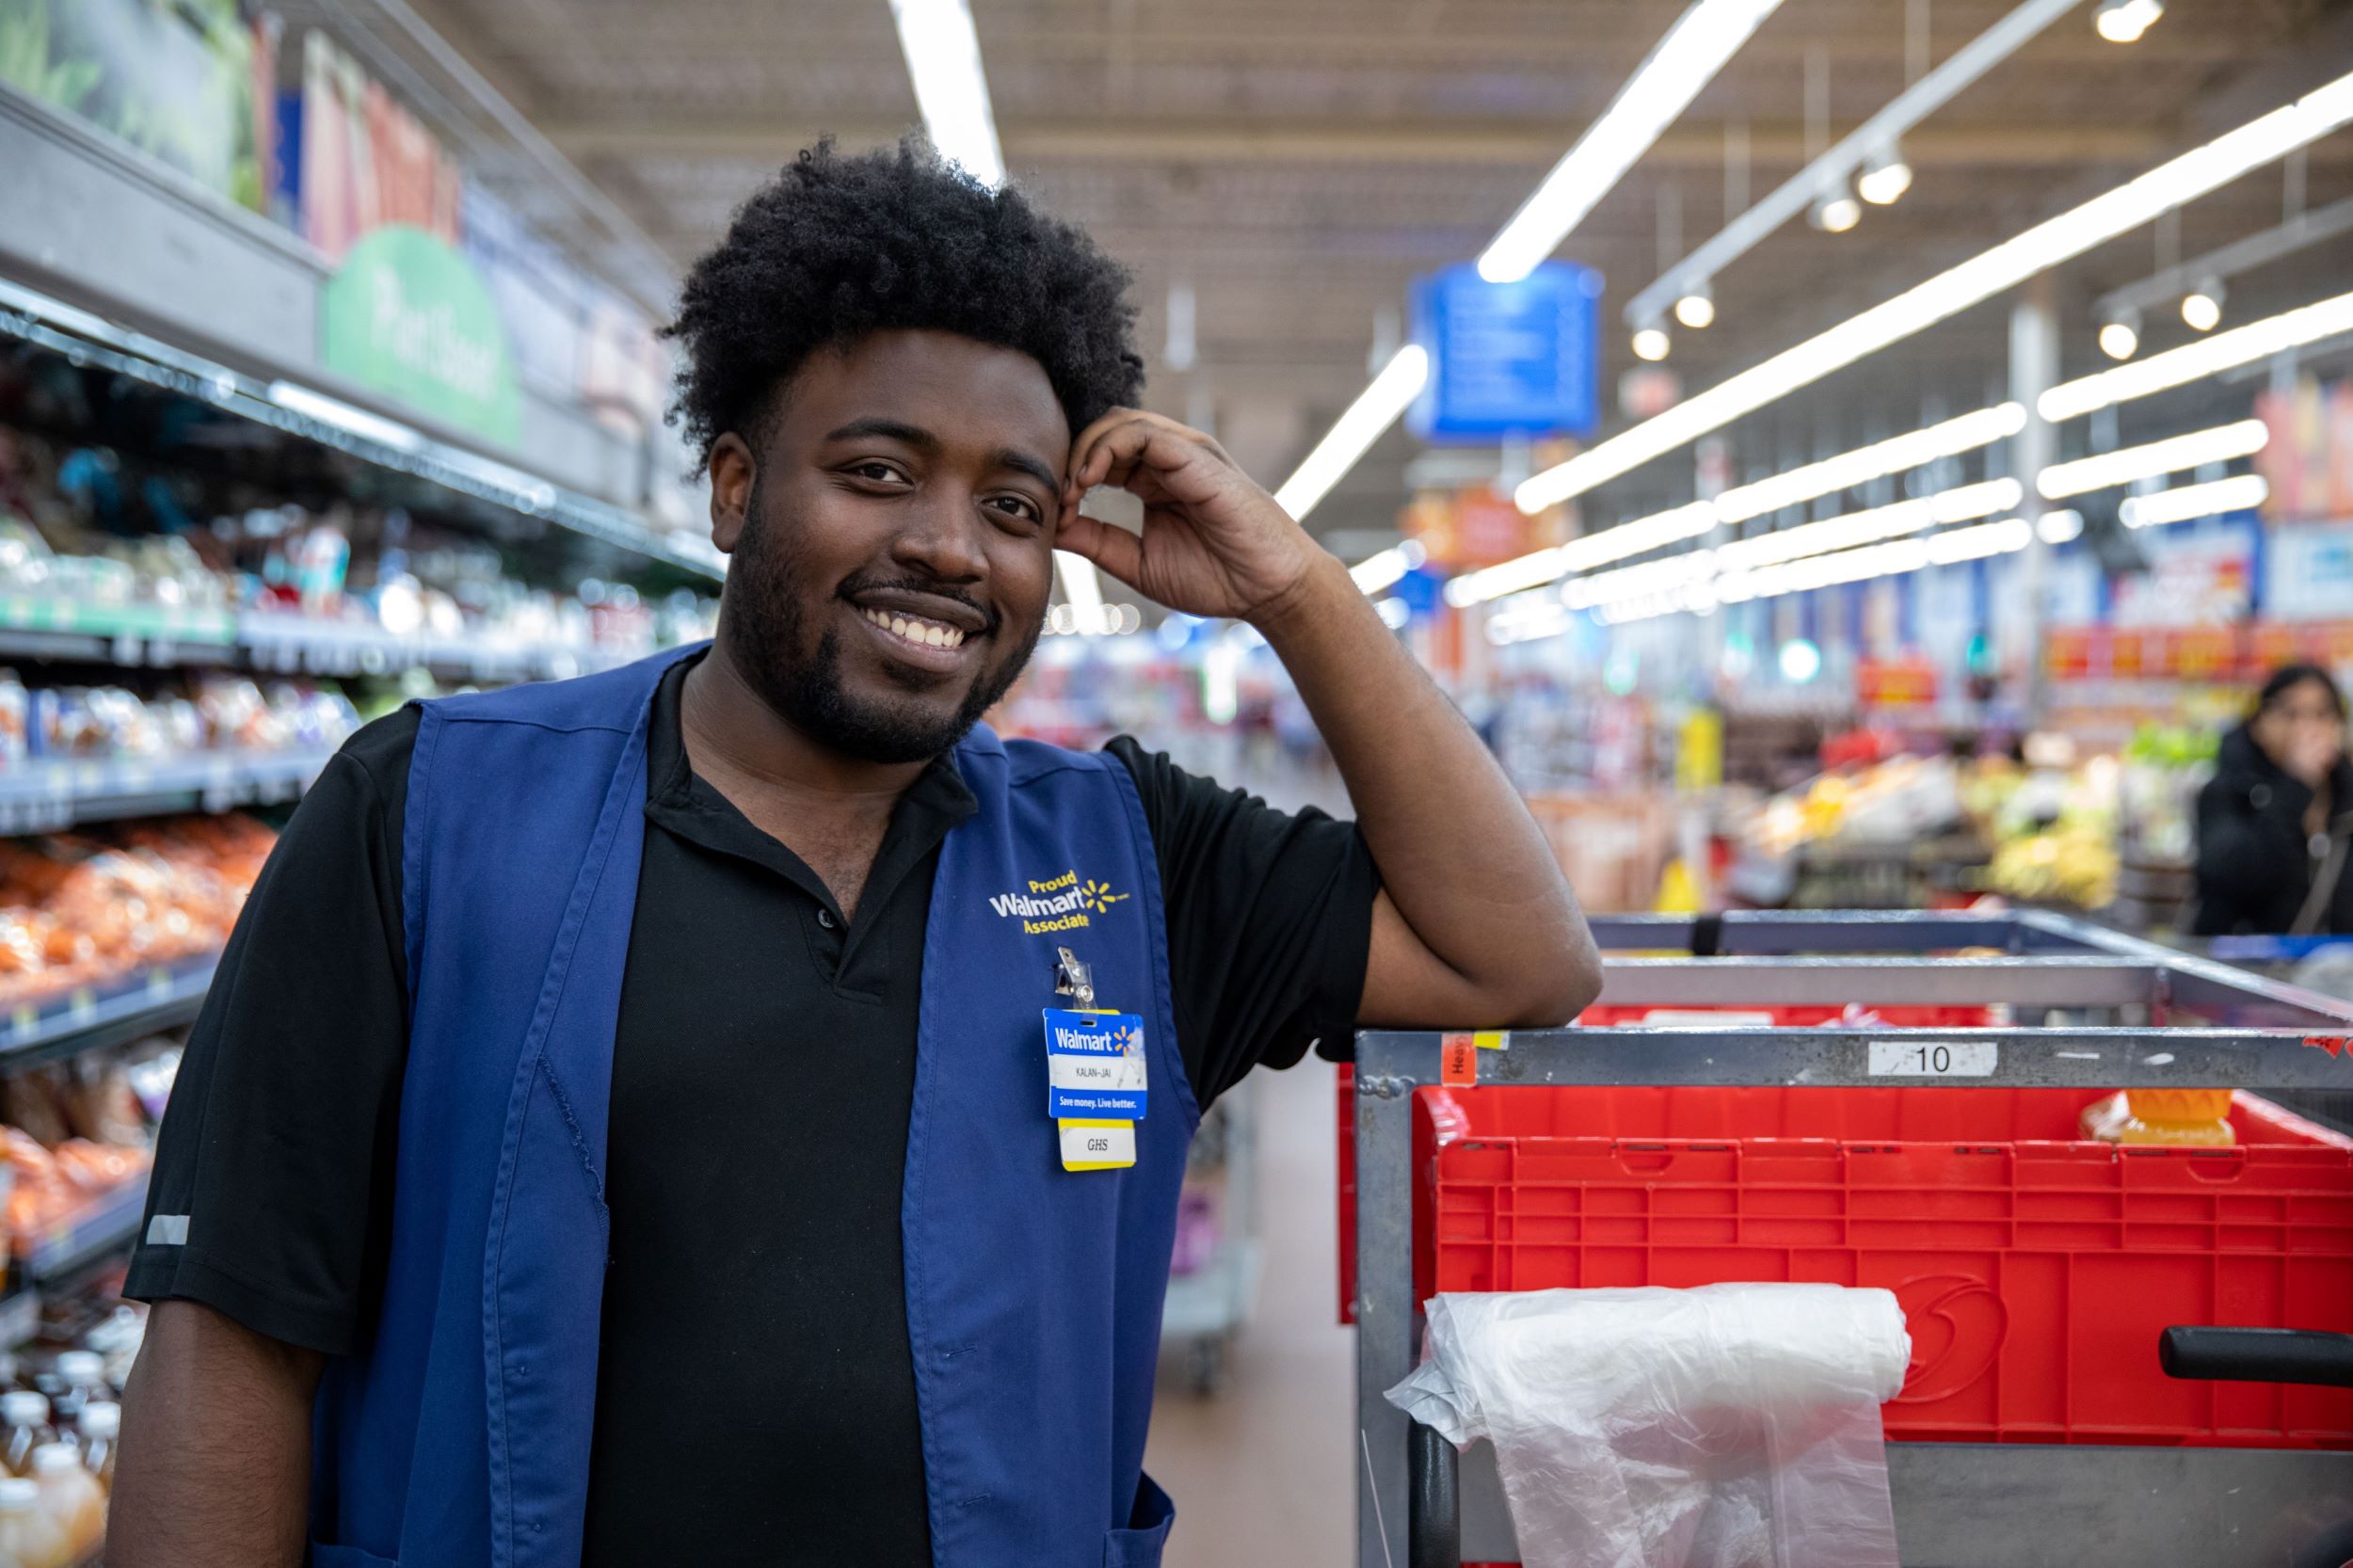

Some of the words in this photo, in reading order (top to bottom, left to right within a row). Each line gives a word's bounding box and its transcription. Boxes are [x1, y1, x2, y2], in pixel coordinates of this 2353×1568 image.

[1028, 870, 1078, 893] Proud
[988, 886, 1085, 918] Walmart
[1023, 913, 1090, 935] Associate
[1054, 1027, 1112, 1051] Walmart
[1915, 1046, 1950, 1073] 10
[1076, 1067, 1112, 1079] KALAN-JAI
[1060, 1096, 1074, 1106] Save
[1074, 1098, 1096, 1110] money.
[1097, 1097, 1112, 1109] Live
[1112, 1098, 1137, 1109] better.
[1087, 1138, 1109, 1151] GHS
